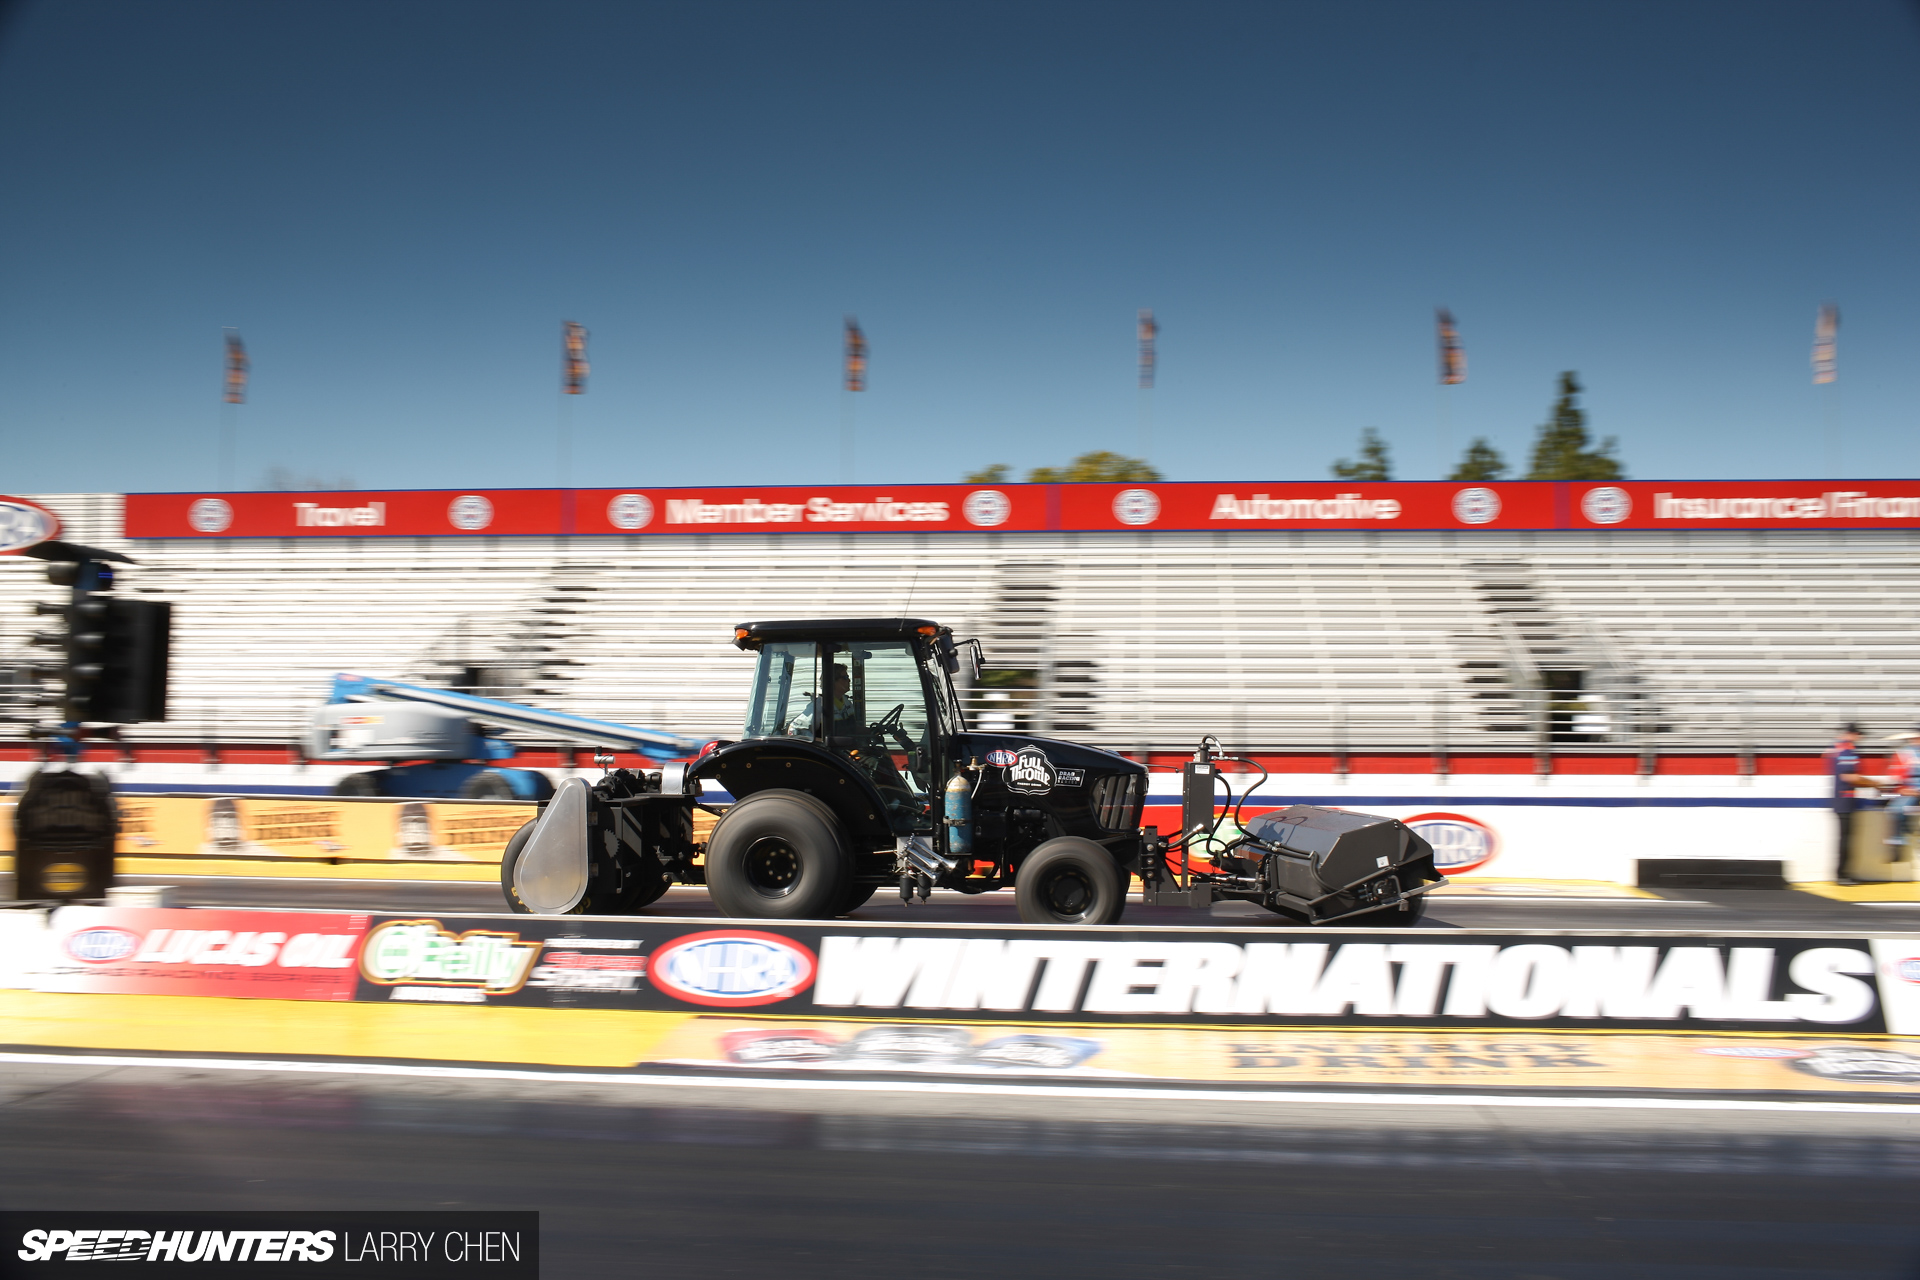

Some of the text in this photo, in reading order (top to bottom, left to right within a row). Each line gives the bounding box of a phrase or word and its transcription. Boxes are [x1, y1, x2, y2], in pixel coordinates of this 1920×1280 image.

[293, 501, 386, 527] Travel
[665, 499, 804, 524] Member
[805, 497, 949, 522] Services
[1209, 493, 1401, 520] Automotive
[987, 751, 1016, 765] NHRA
[1018, 754, 1042, 771] Full
[131, 928, 359, 968] LUCAS OIL
[669, 942, 799, 992] NHRA
[812, 936, 1876, 1024] WINTERNATIONALS
